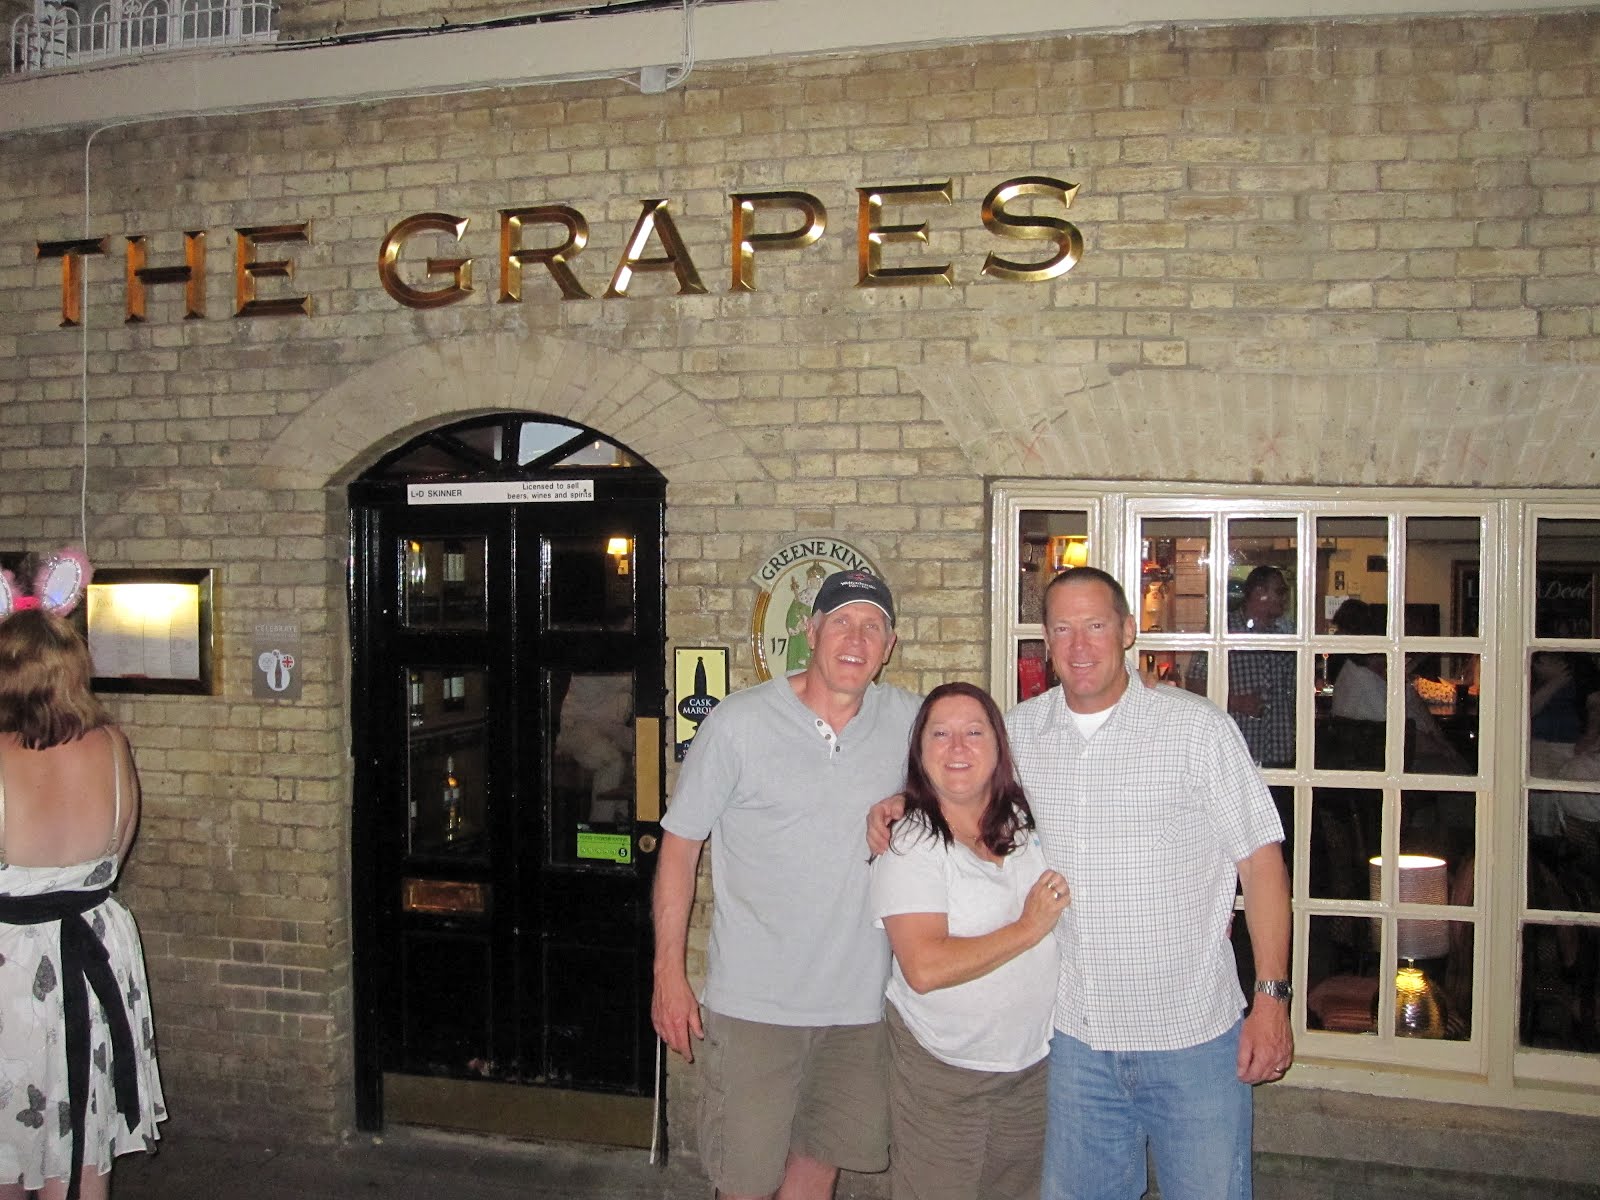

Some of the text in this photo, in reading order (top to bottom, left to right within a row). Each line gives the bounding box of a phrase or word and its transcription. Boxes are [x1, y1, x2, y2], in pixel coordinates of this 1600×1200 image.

[36, 175, 1084, 328] THE GRAPES
[522, 482, 554, 491] Licensed
[556, 482, 564, 490] to
[427, 489, 463, 498] SKINNER
[507, 489, 592, 500] beers, wines and spirits
[761, 541, 828, 581] GREENE
[689, 699, 712, 707] CASK
[620, 848, 627, 857] 5
